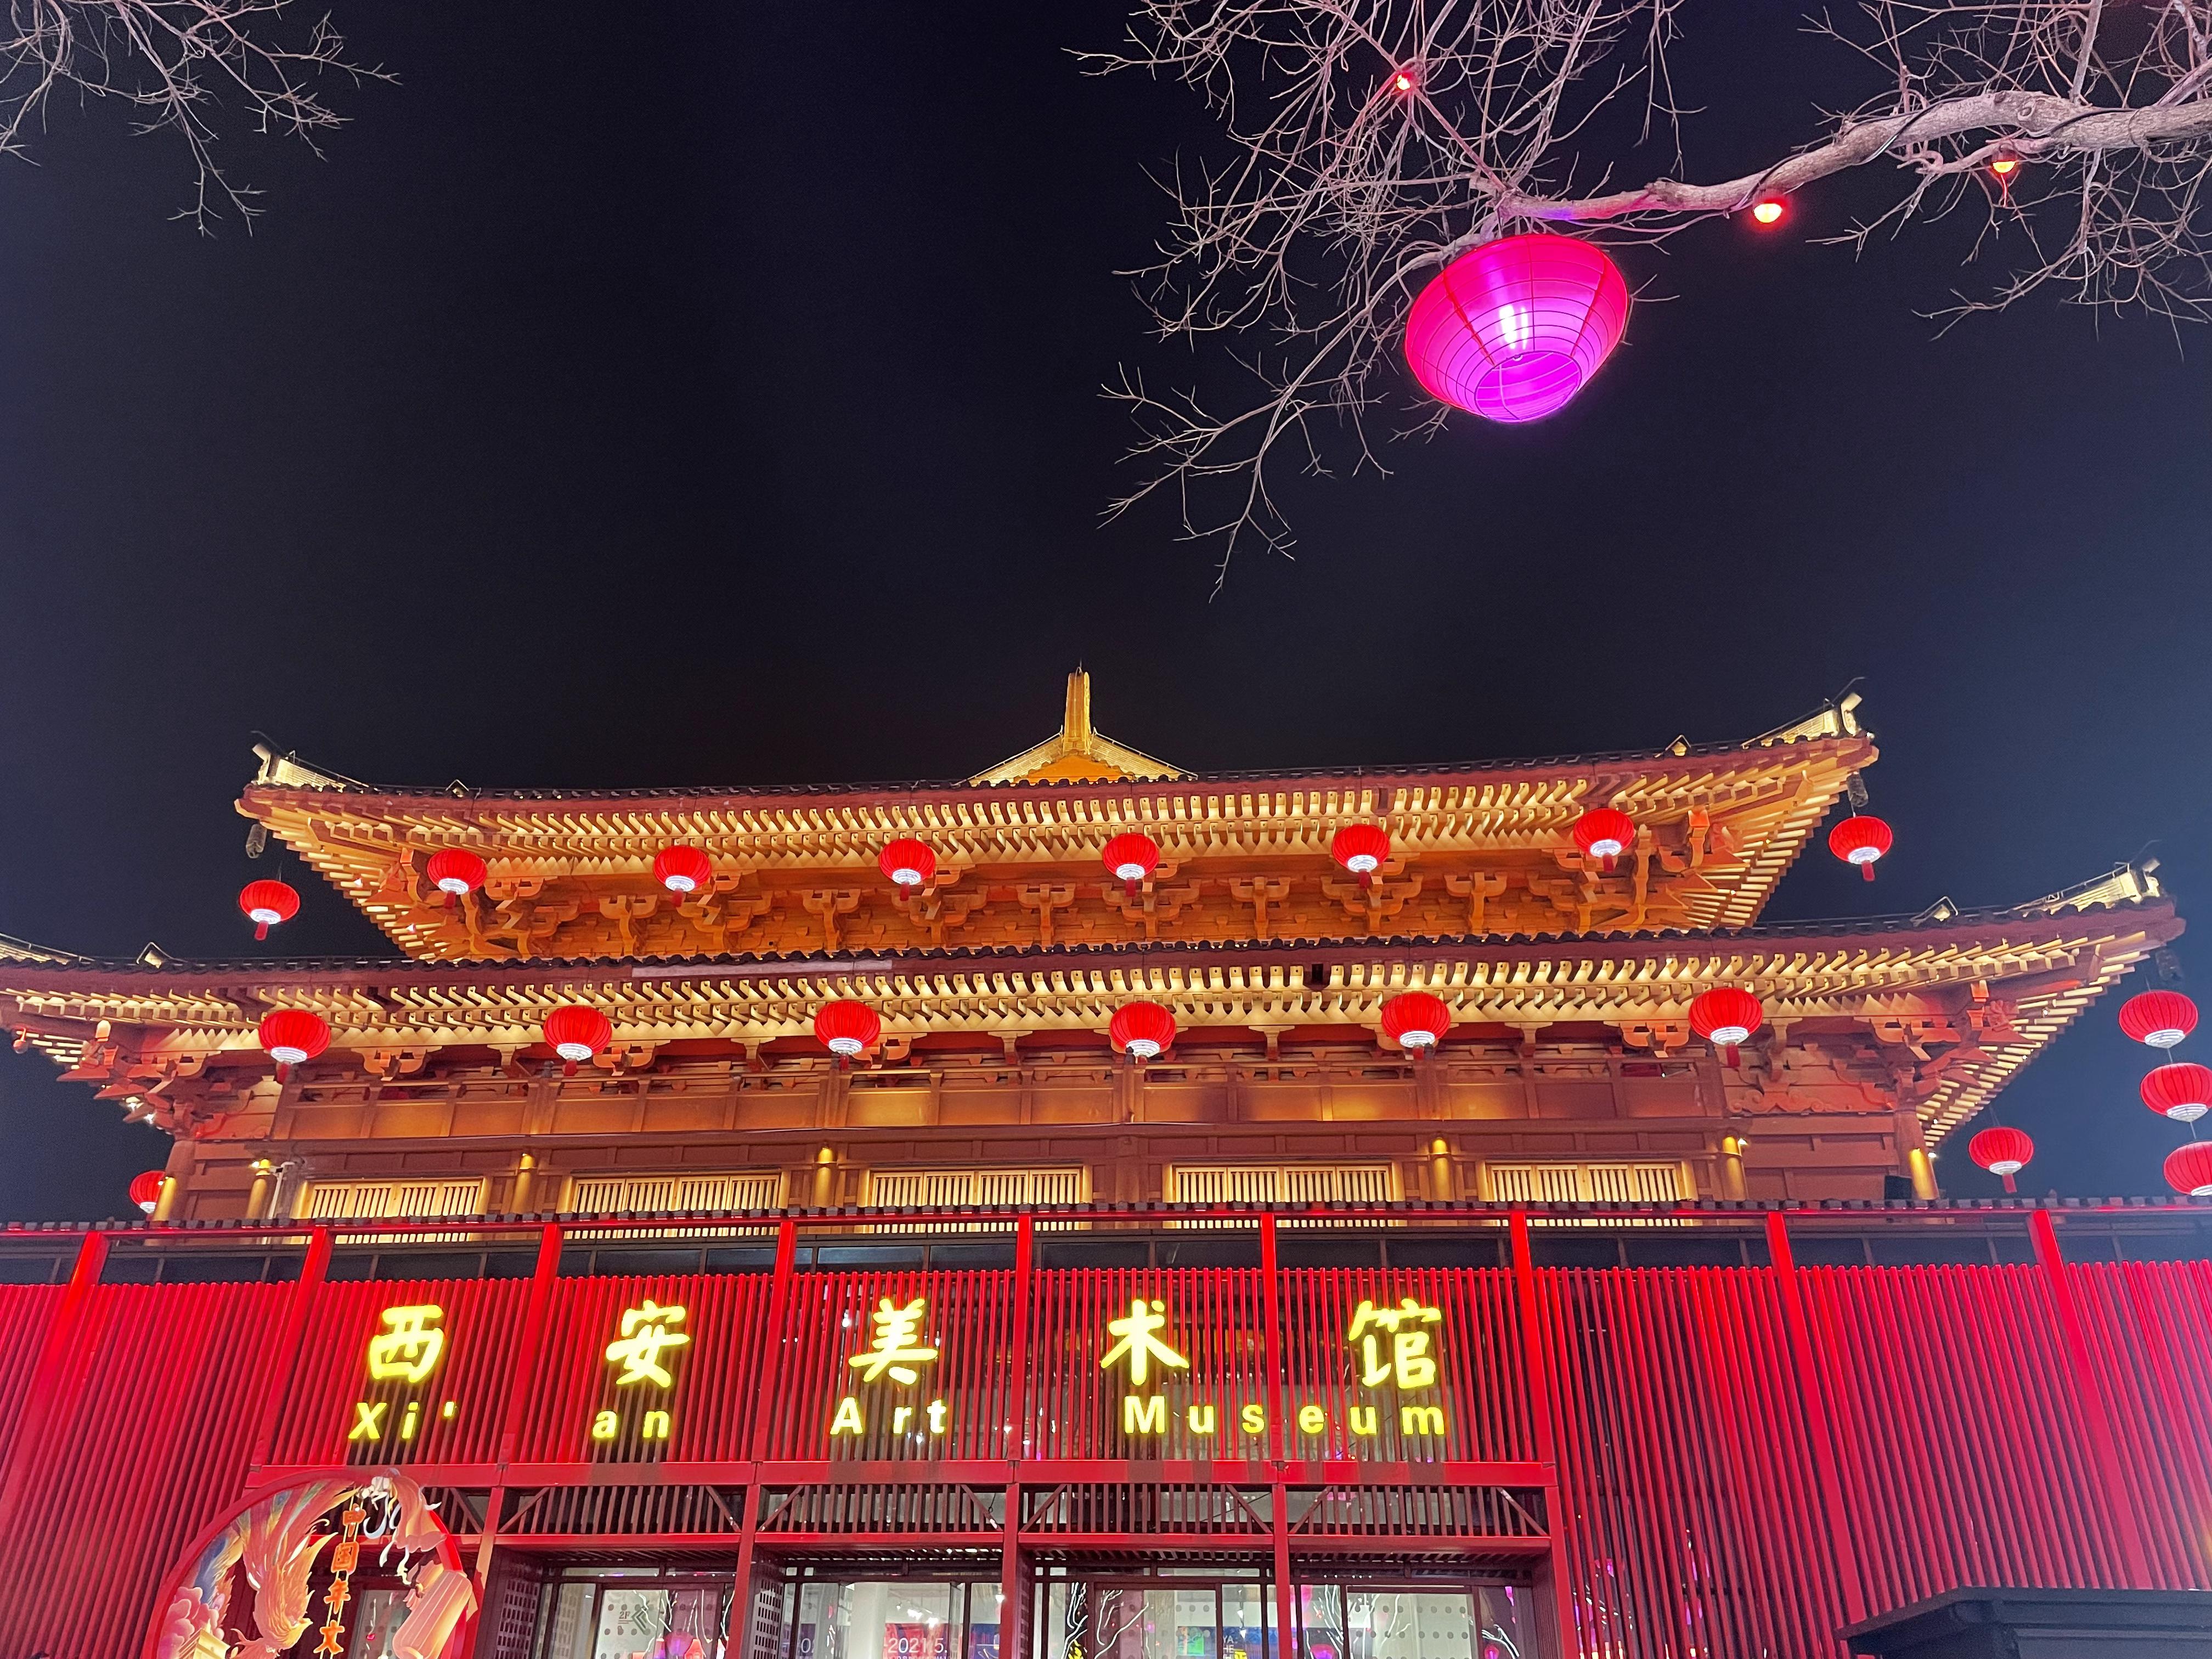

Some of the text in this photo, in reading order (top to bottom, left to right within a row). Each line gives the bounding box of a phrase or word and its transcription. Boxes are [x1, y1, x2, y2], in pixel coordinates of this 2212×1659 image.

[369, 1298, 1441, 1389] 西安美术馆
[830, 1396, 946, 1435] Art
[1124, 1395, 1445, 1435] Museum
[618, 1611, 630, 1620] 2F
